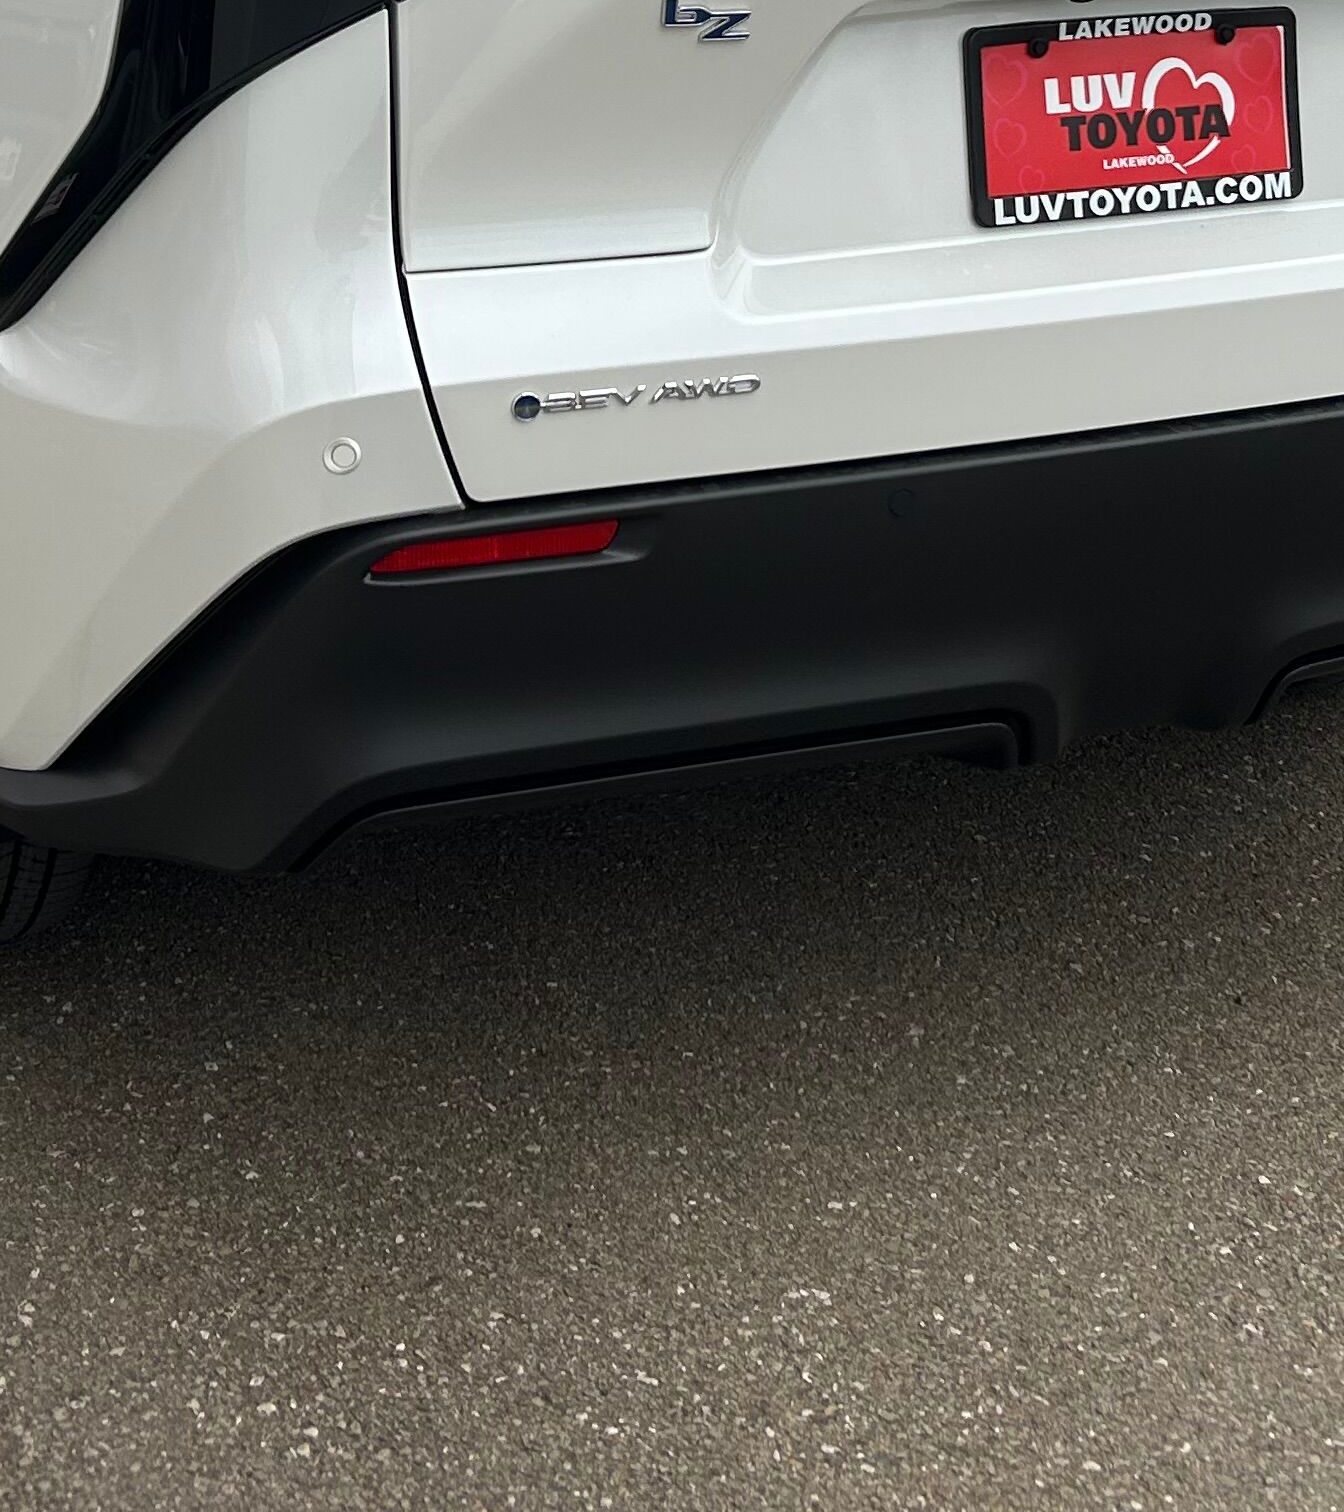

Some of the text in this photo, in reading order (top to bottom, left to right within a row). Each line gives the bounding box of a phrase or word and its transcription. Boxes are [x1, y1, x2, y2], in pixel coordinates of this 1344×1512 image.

[1058, 12, 1213, 42] LAKEWOOD
[1044, 72, 1136, 115] LUV
[1061, 104, 1231, 152] TOYOTA
[1102, 153, 1176, 171] LAKEWOOD
[993, 171, 1293, 226] LUVTOYOTA.COM
[543, 373, 761, 413] BEV AWD
